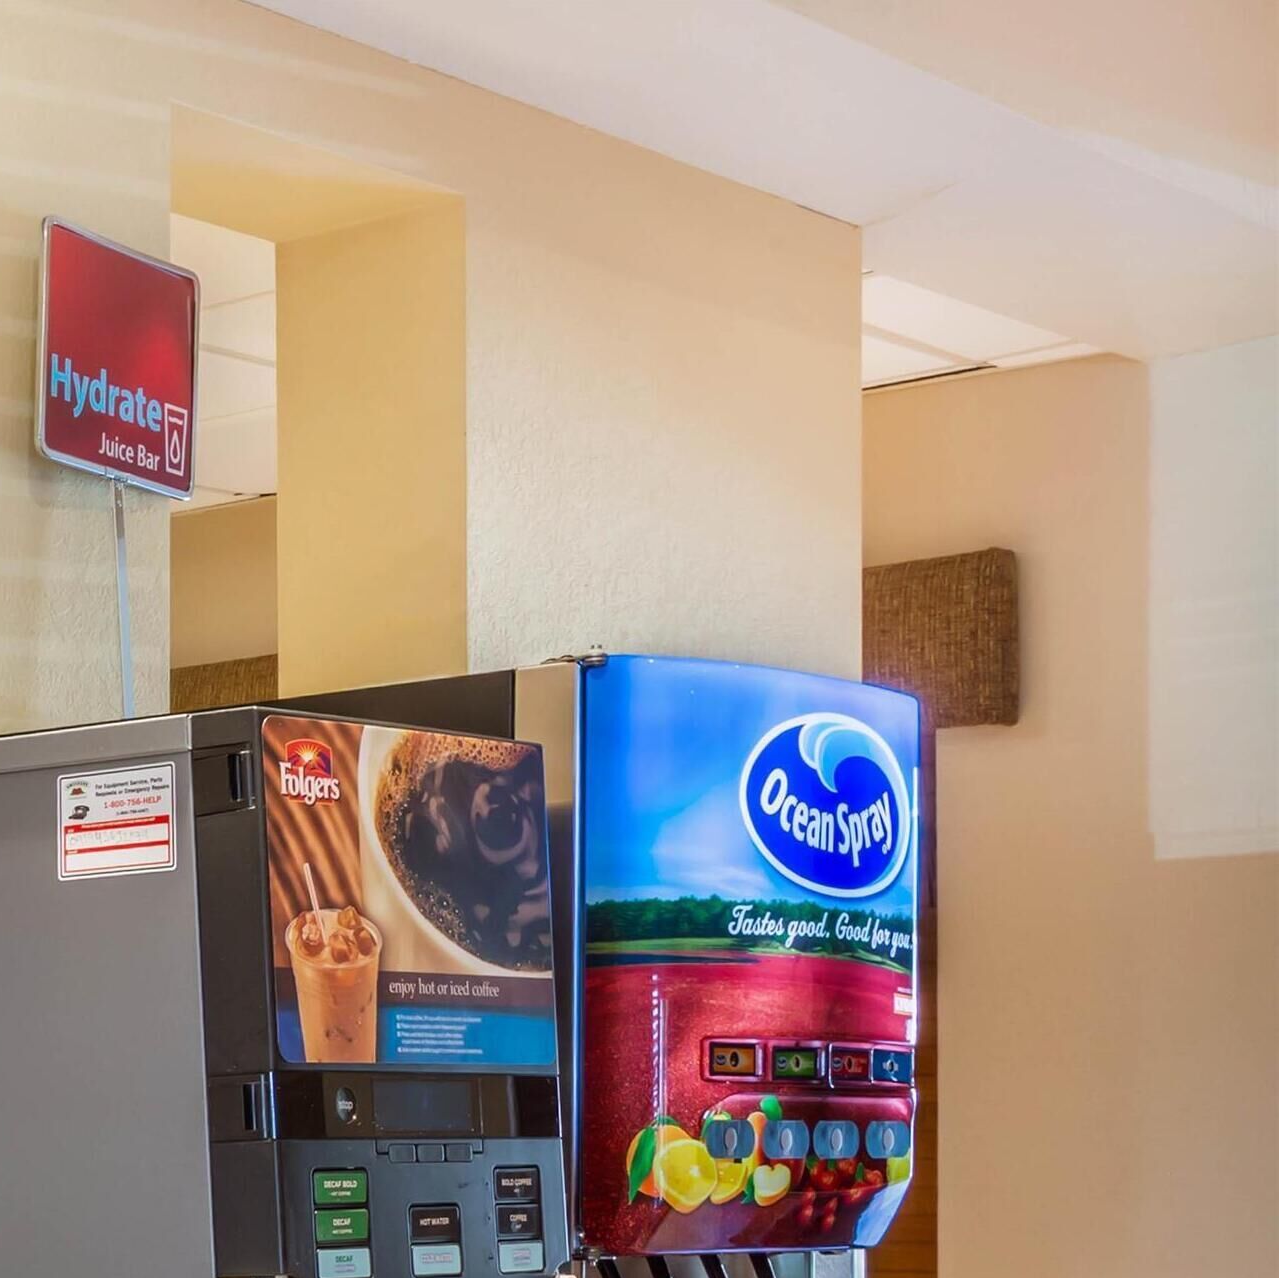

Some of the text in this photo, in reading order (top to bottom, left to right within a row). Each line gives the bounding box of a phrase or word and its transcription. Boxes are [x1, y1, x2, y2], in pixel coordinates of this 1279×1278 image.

[50, 353, 162, 432] Hydrate
[98, 432, 160, 471] Juice Bar
[279, 761, 340, 803] Folgers
[760, 768, 893, 867] Ocean Spray
[728, 905, 784, 935] Tastes
[785, 912, 830, 948] good.
[835, 913, 872, 942] Good
[871, 920, 890, 949] for
[389, 977, 500, 999] enjoy hot or iced coffee
[419, 1217, 449, 1226] HOT WATER
[335, 1255, 353, 1263] DECAF
